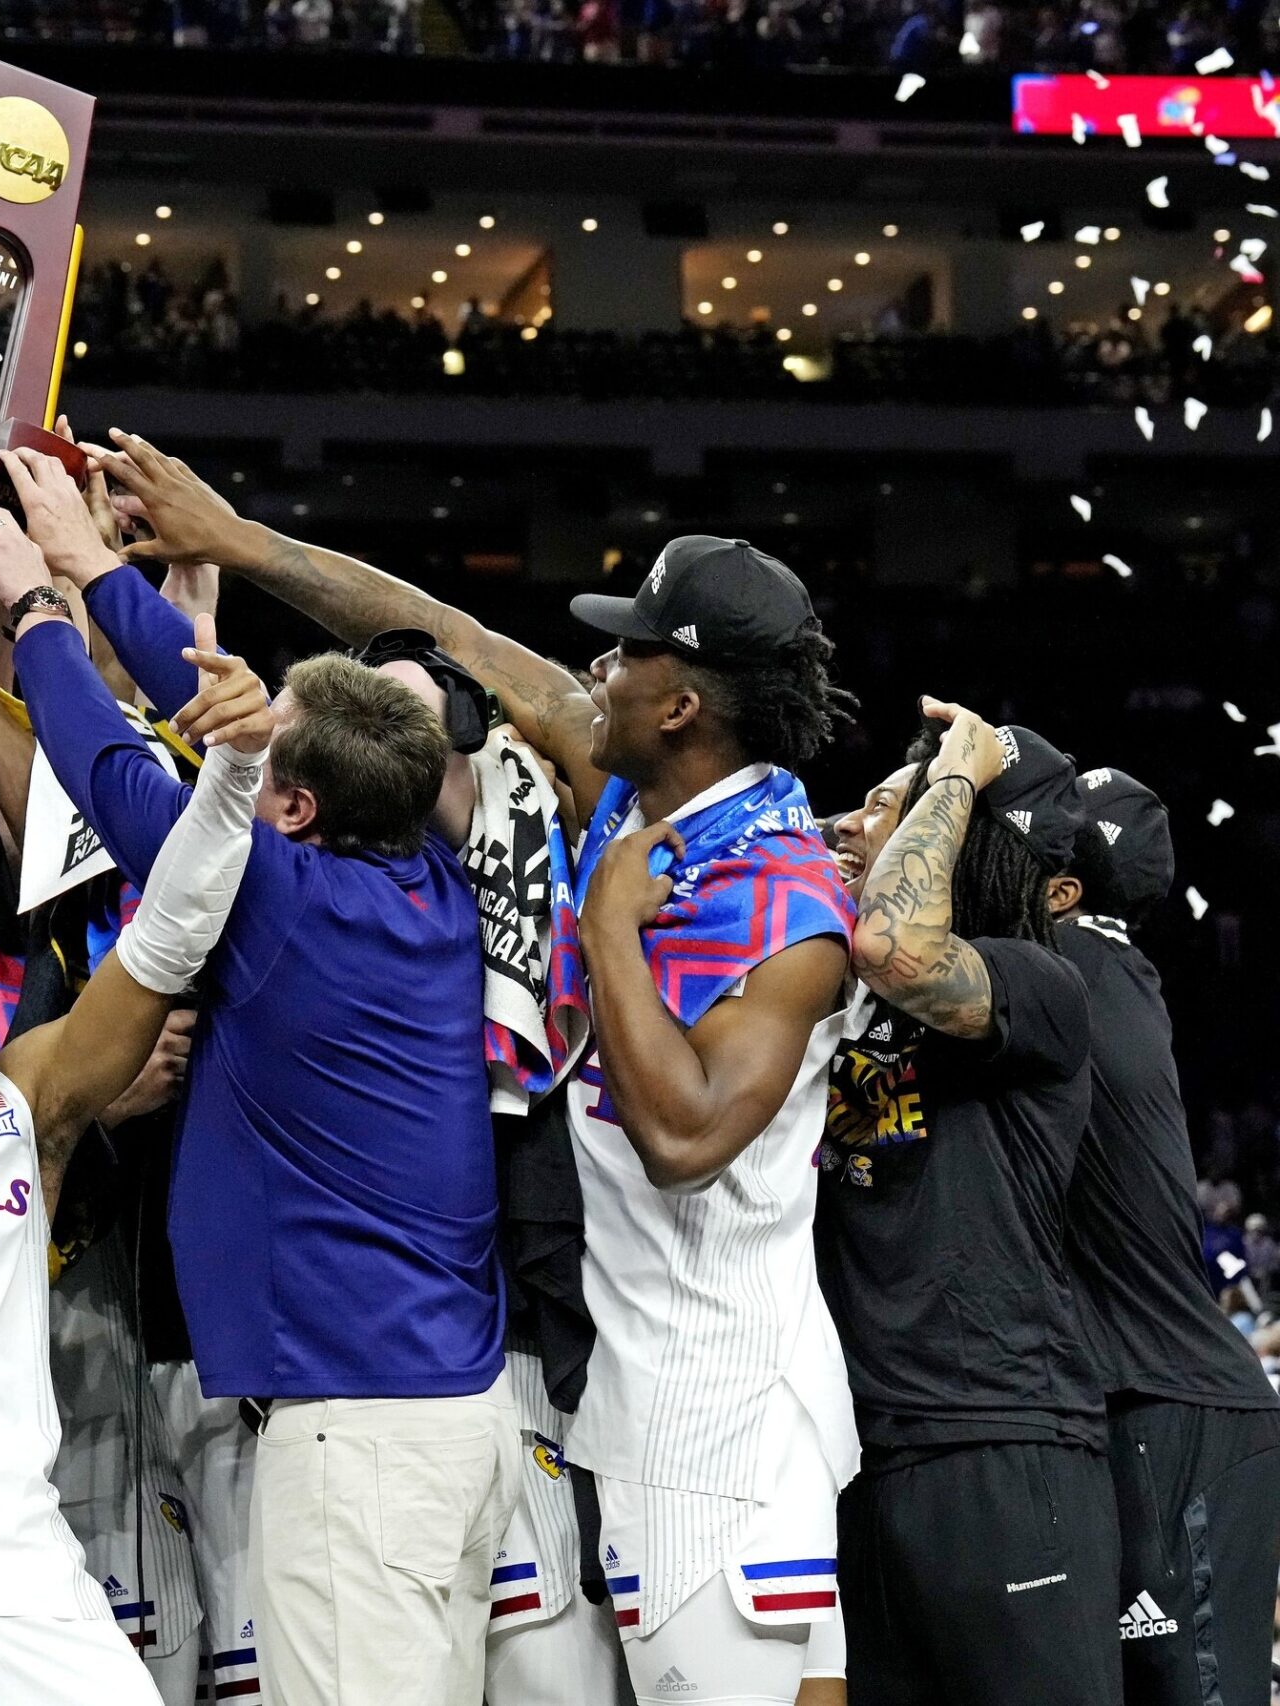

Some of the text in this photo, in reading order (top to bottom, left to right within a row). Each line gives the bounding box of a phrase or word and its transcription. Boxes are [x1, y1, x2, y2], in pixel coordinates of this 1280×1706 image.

[9, 275, 18, 289] I
[672, 629, 700, 649] adidas
[1005, 811, 1031, 835] adidas
[1006, 1573, 1067, 1593] Humanrace
[655, 1681, 698, 1693] adidas
